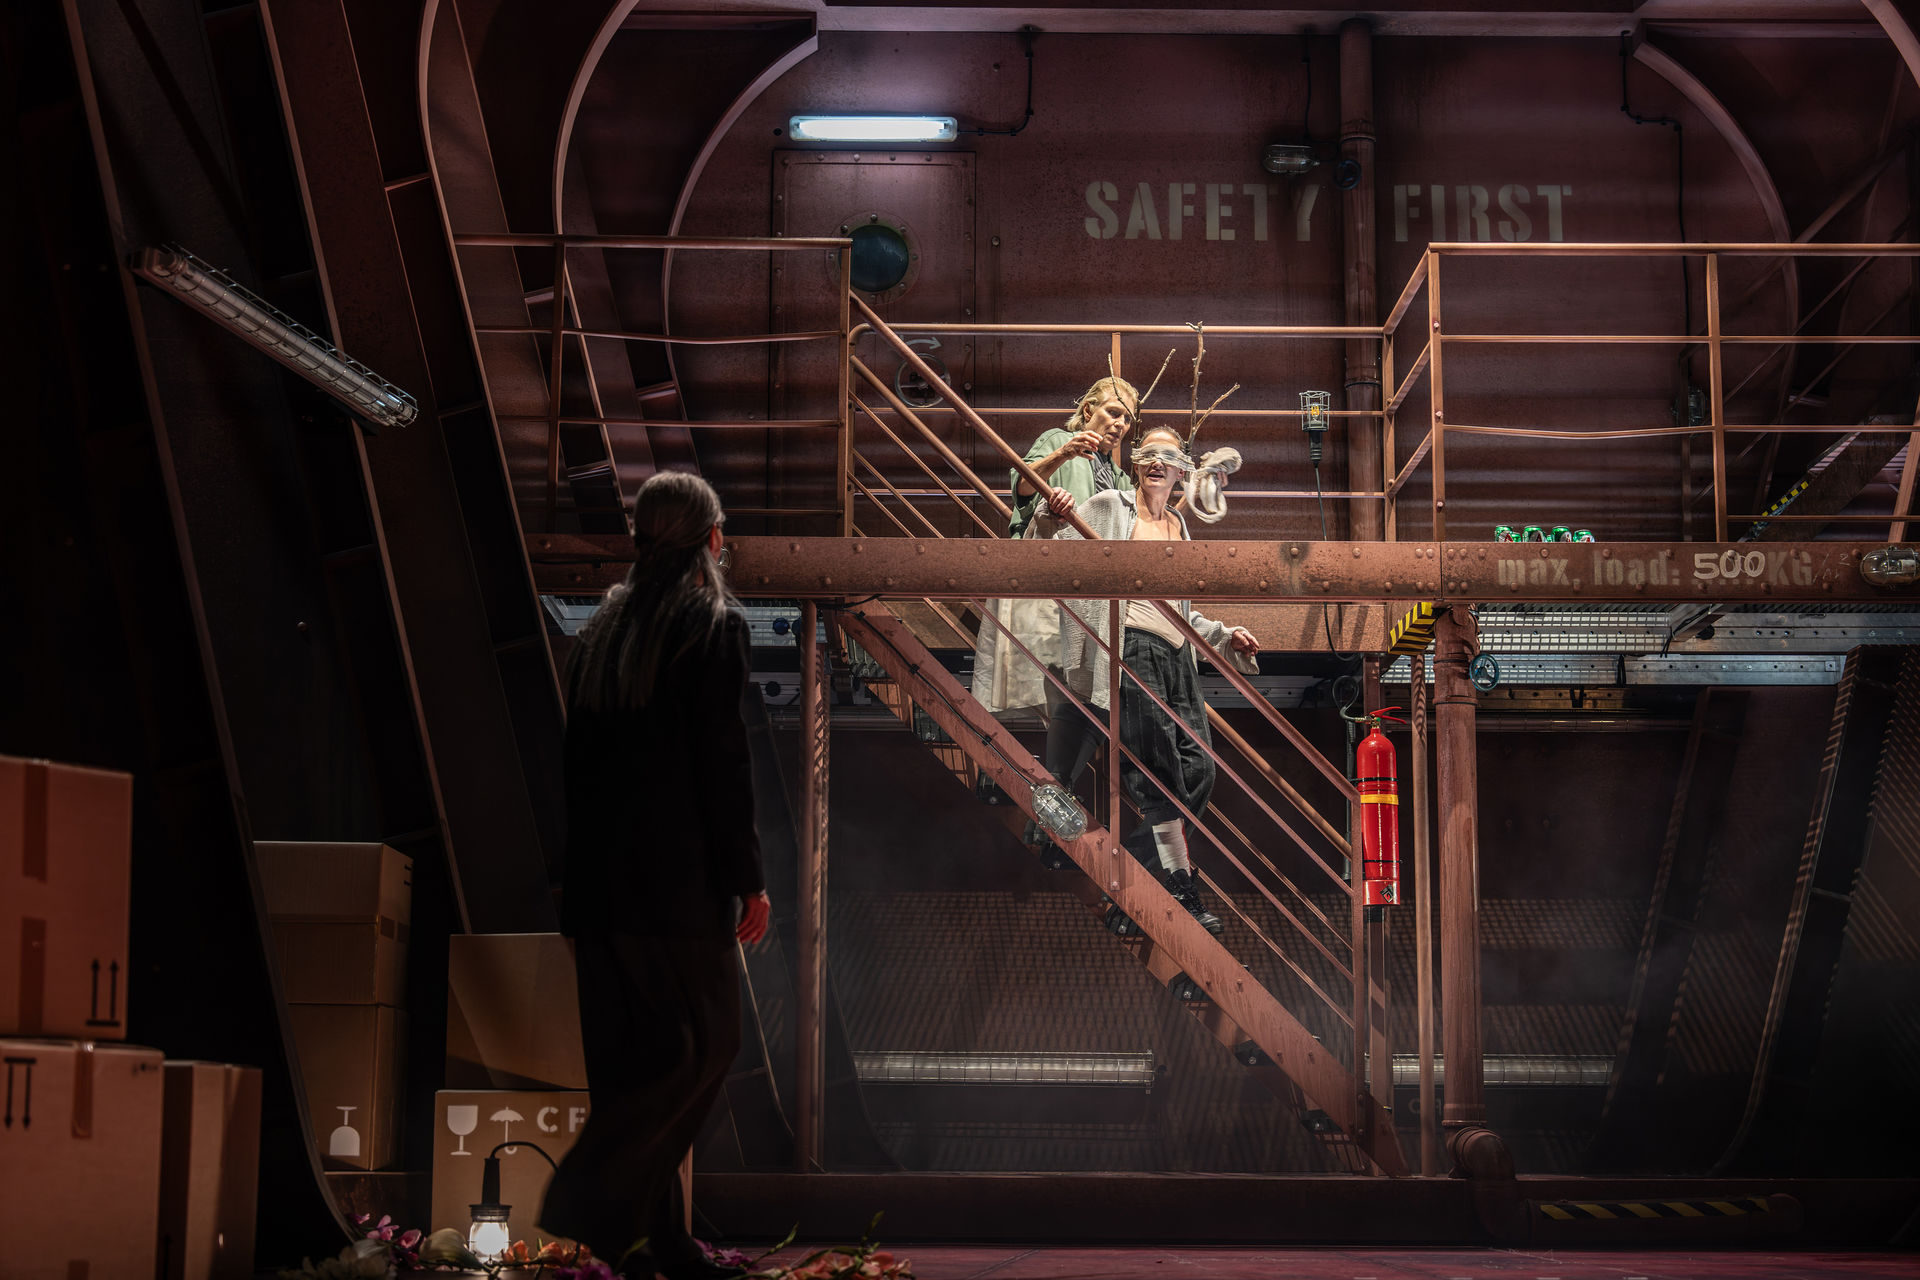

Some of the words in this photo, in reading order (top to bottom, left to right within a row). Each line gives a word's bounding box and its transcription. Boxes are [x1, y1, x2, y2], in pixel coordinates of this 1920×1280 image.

[1084, 181, 1320, 242] SAFETY
[1394, 183, 1573, 242] FIRST
[1498, 558, 1581, 587] max.
[1594, 550, 1680, 586] load:
